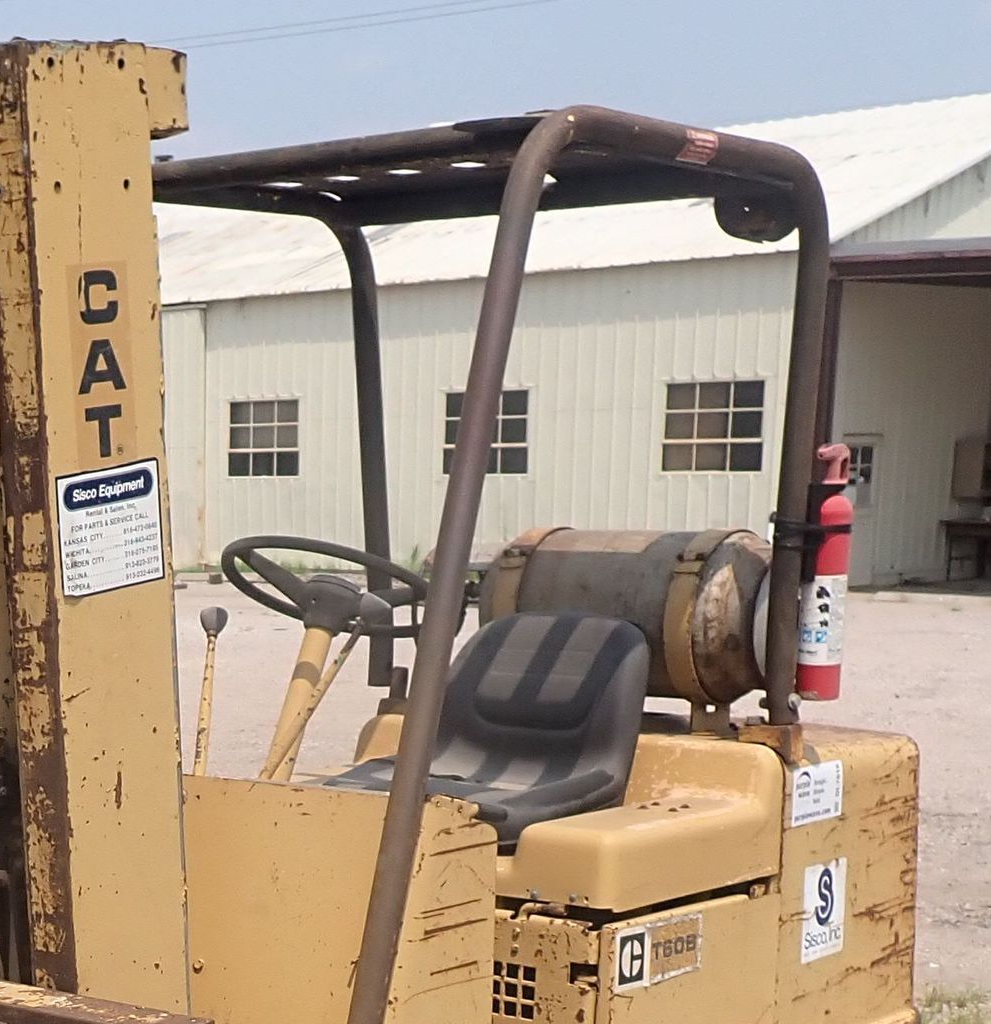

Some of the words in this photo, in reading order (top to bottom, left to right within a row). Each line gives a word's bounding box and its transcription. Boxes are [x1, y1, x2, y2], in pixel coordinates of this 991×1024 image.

[78, 269, 127, 458] CAT
[72, 487, 97, 503] Sisco
[98, 475, 145, 499] Equipment
[85, 508, 103, 517] Rental
[71, 524, 84, 534] FOR
[84, 520, 103, 531] PARTS
[104, 519, 108, 527] &
[109, 514, 133, 526] SERVICE
[134, 511, 149, 522] CALL
[64, 536, 88, 546] KANSAS
[90, 532, 104, 542] CITY
[65, 548, 90, 559] WICHITA
[65, 557, 90, 570] GARDEN
[91, 556, 105, 566] CITY
[66, 571, 88, 582] SALINA
[67, 582, 91, 593] TOPEKA
[652, 932, 697, 961] T60B
